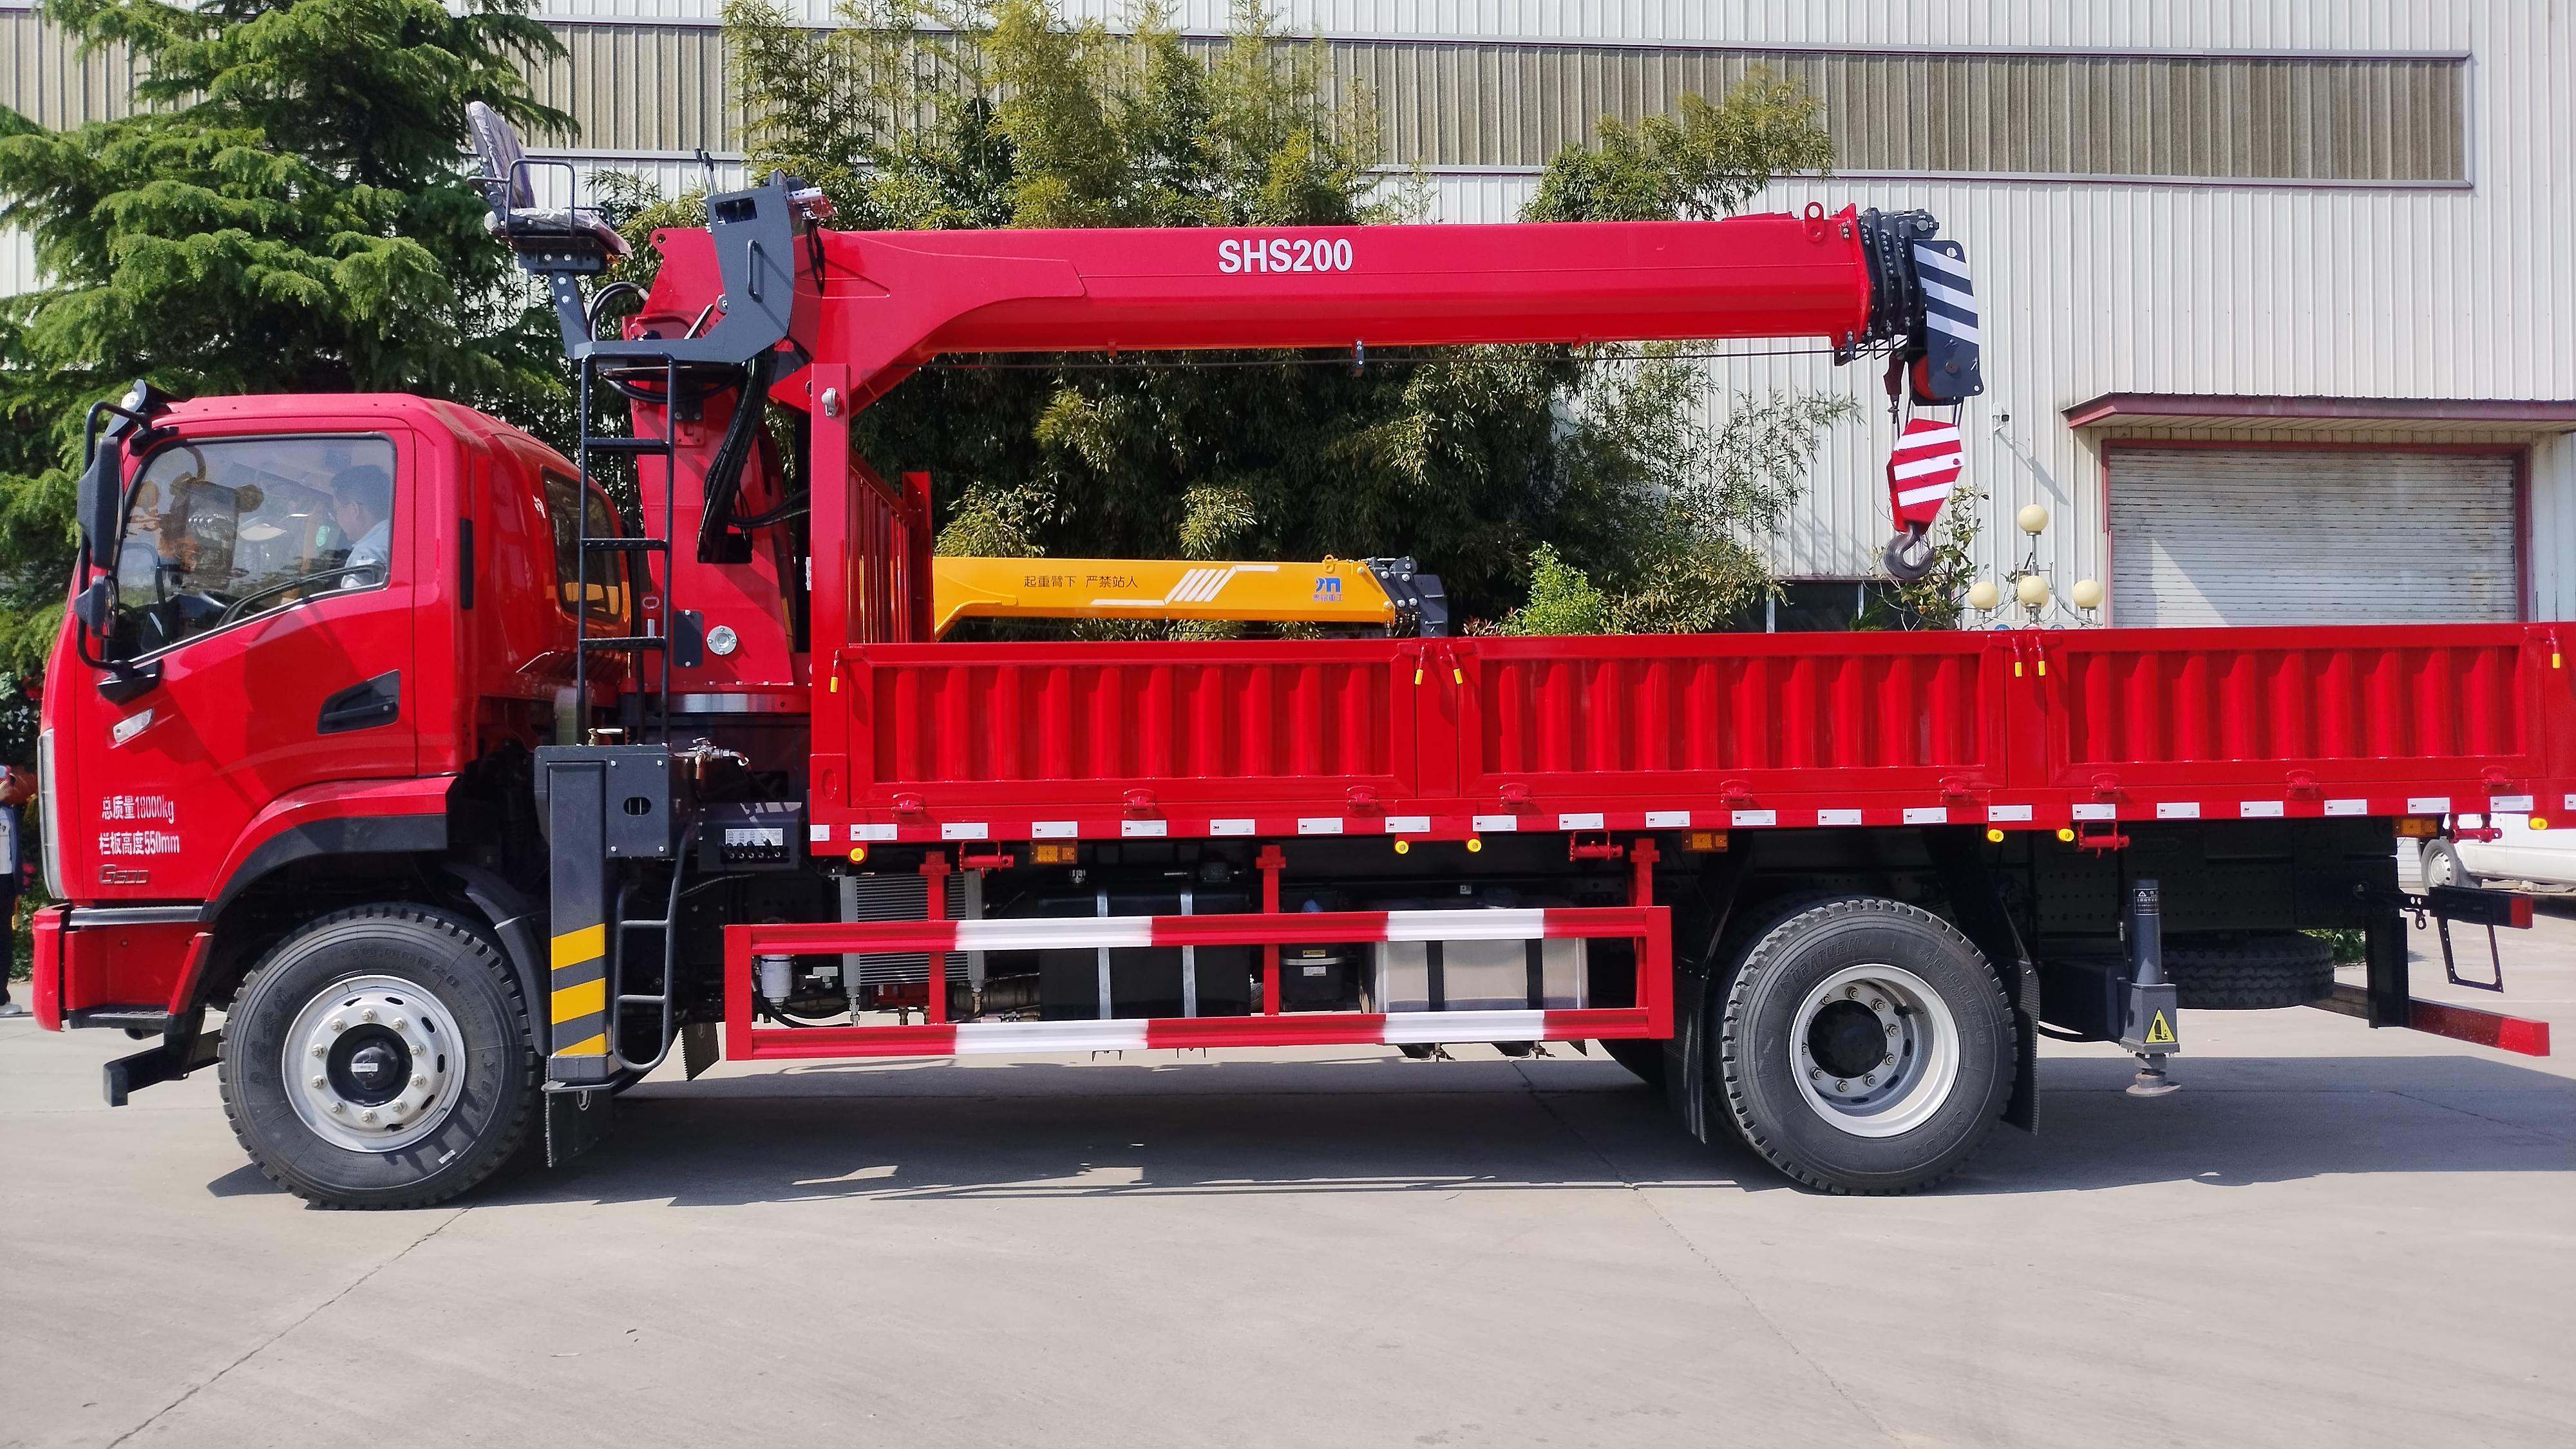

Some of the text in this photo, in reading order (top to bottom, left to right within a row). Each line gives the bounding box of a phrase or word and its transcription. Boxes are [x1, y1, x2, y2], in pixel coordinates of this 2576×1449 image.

[1218, 238, 1353, 273] SHS200
[1024, 575, 1138, 588] 起重臂下 严禁站人
[102, 795, 175, 824] 总质量18000kg
[99, 830, 180, 855] 栏板高度550mm
